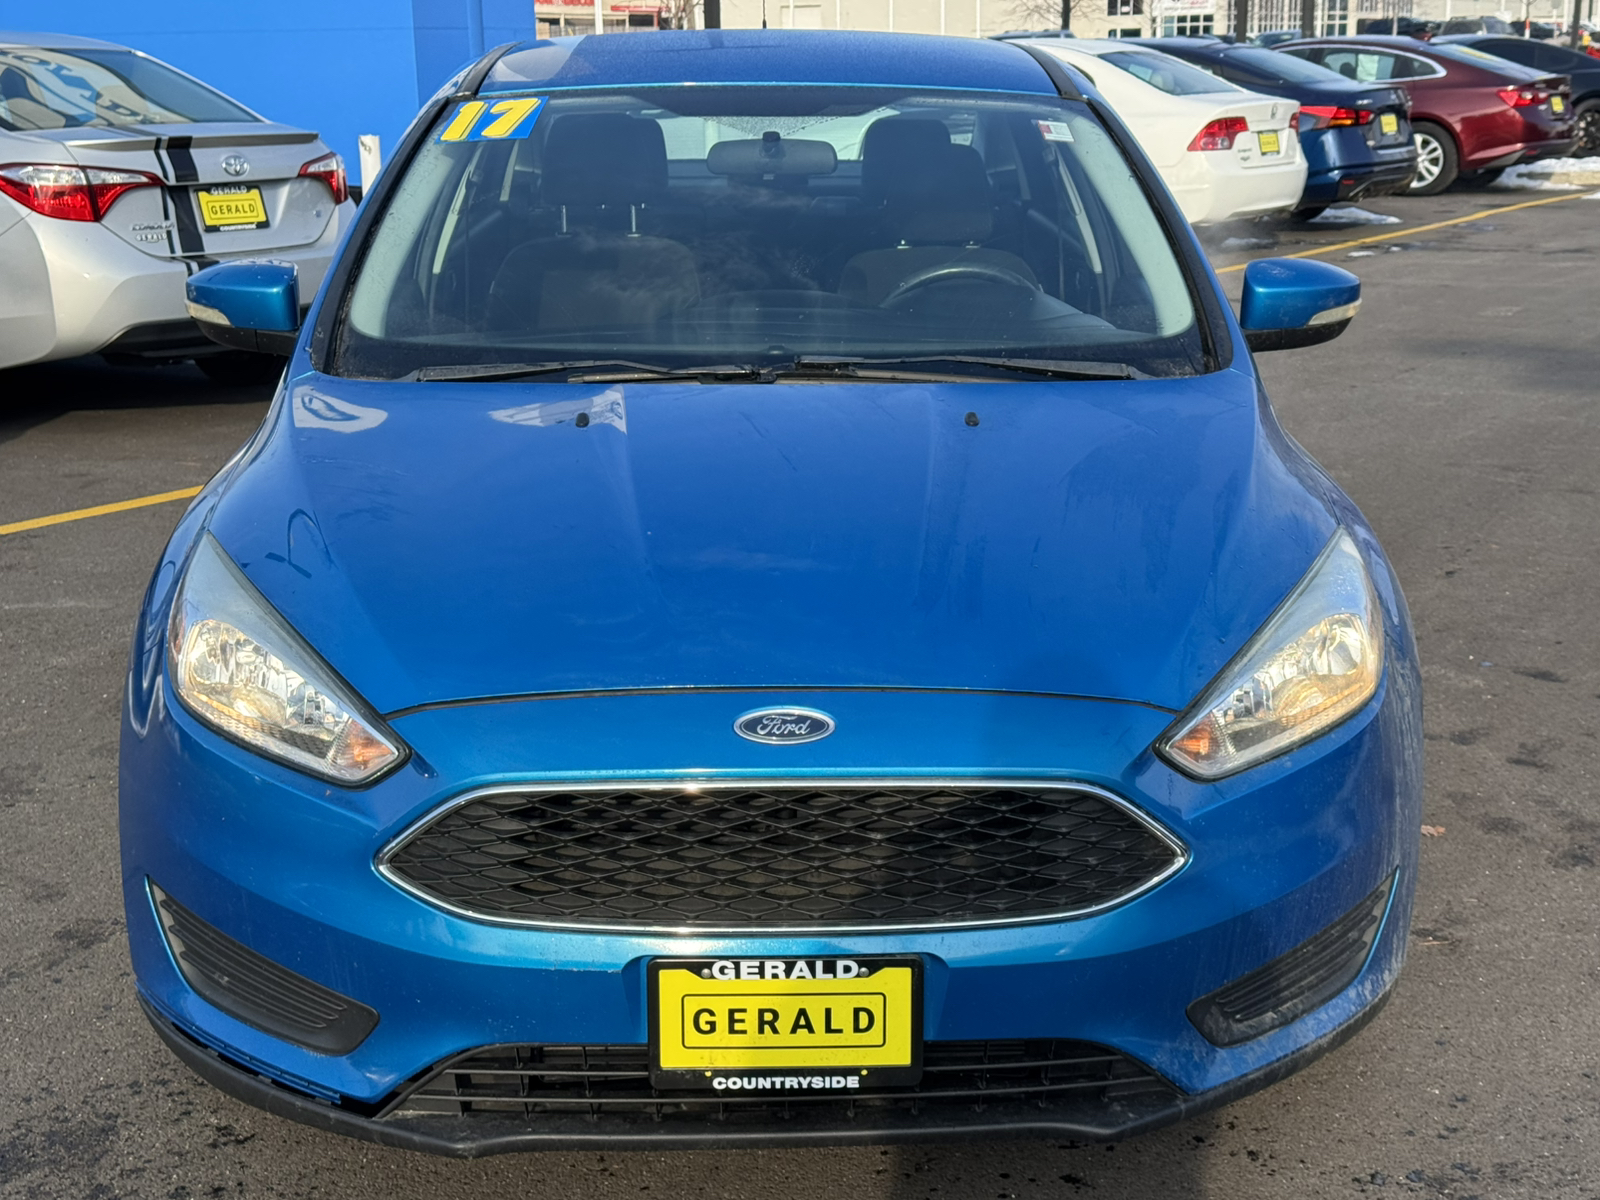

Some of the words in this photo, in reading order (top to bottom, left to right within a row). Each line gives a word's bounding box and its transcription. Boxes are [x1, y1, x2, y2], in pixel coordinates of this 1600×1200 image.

[441, 98, 541, 142] 17
[210, 203, 256, 216] GERALD
[757, 715, 811, 735] Ford
[711, 960, 860, 981] GERALD
[692, 1007, 876, 1035] GERALD
[712, 1076, 860, 1090] COUNTRYSIDE
